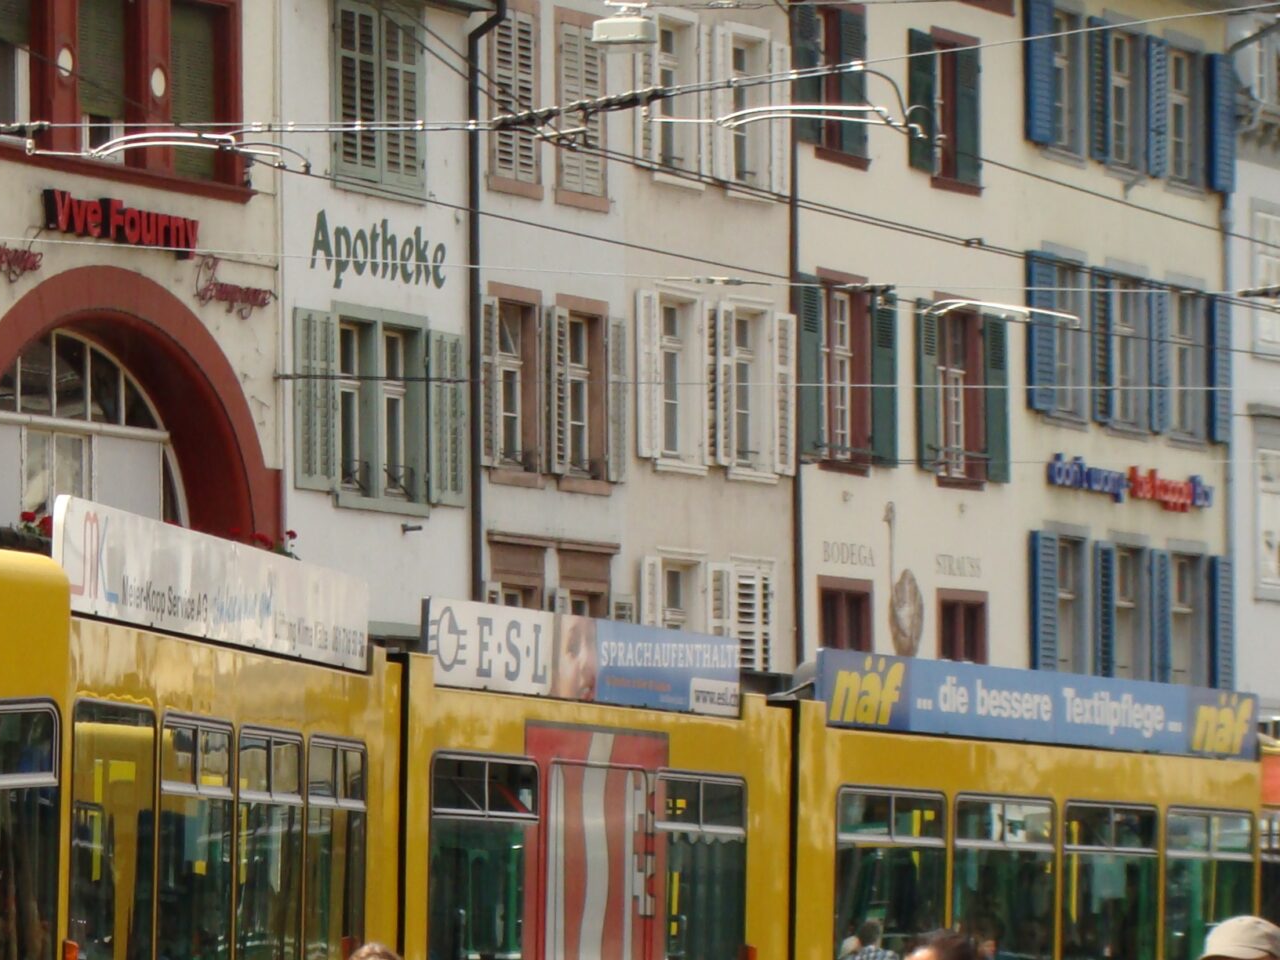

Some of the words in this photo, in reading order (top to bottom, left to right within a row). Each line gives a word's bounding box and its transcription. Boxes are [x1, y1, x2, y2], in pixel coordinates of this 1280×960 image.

[50, 188, 102, 238] Vve
[106, 197, 199, 260] Fourny
[309, 208, 447, 290] Apotheke
[822, 540, 876, 568] BODEGA
[829, 655, 906, 726] näf
[938, 675, 969, 714] die
[976, 679, 1053, 722] bessere
[1062, 686, 1165, 738] Textilpflege
[1191, 692, 1254, 755] näf
